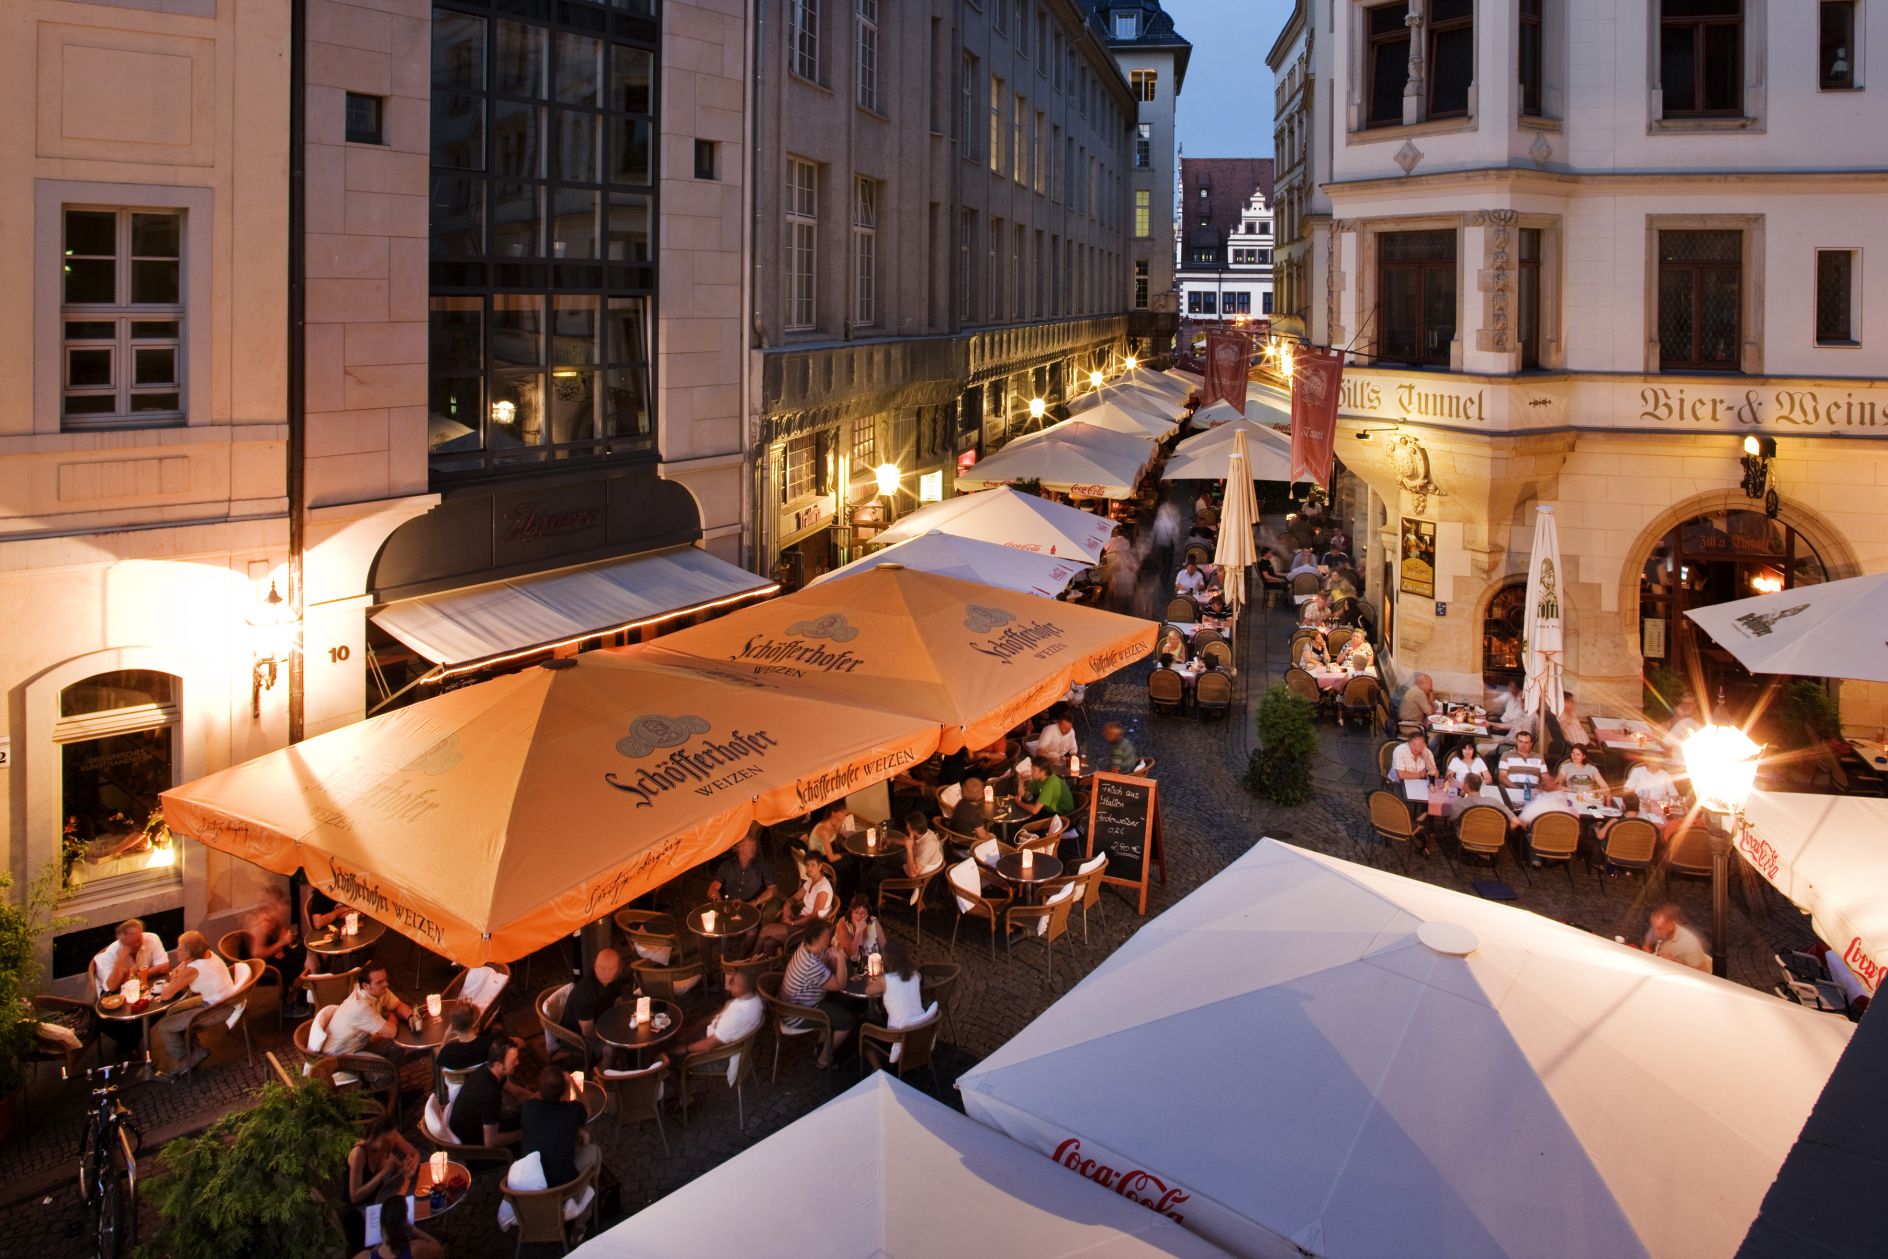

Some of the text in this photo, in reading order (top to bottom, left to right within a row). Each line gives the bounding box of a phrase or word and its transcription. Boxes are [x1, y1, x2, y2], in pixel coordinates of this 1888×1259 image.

[1397, 383, 1486, 422] Tunnel
[328, 645, 351, 664] 10
[728, 633, 865, 673] Schöfferhofer
[969, 620, 1065, 666] Schöfferhofer
[1033, 643, 1068, 661] WEIZEN
[1119, 640, 1148, 662] WEIZEN
[753, 665, 808, 679] WEIZEN
[605, 729, 780, 809] Schöfferhofer
[694, 764, 765, 797] WEIZEN
[796, 747, 916, 811] Schöfferhofer WEIZEN
[1101, 783, 1140, 799] Frisch aus
[327, 856, 445, 945] Schöfferhofer WEIZEN
